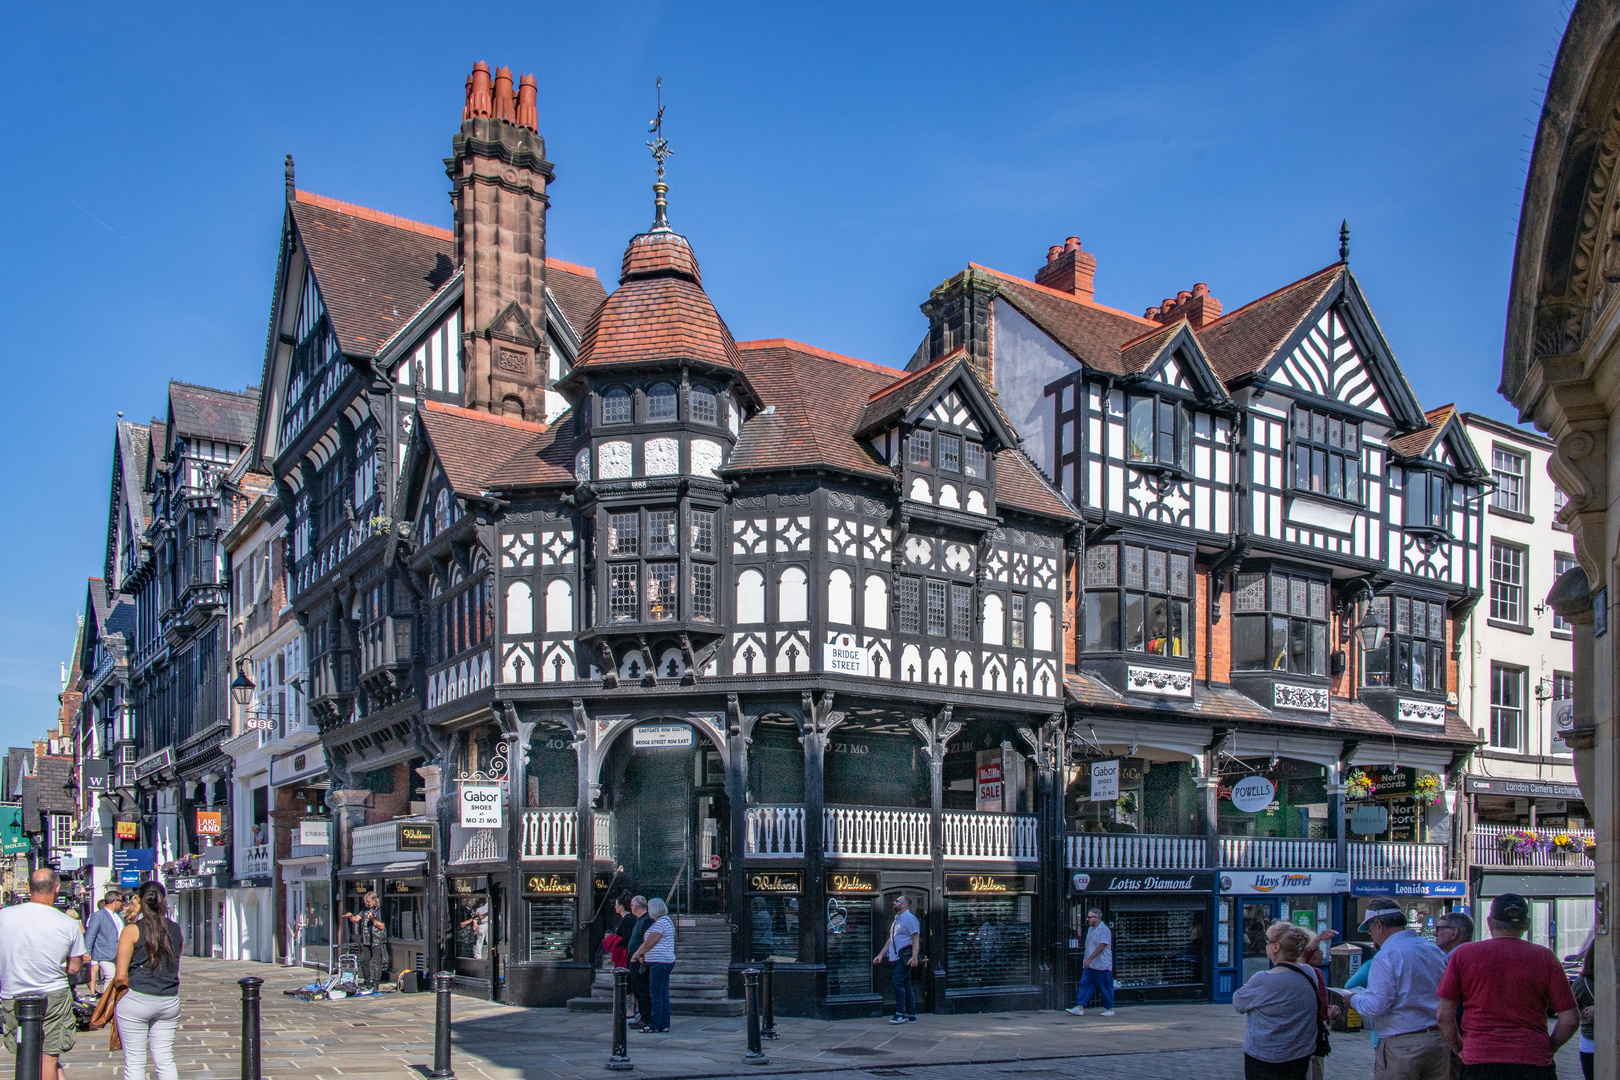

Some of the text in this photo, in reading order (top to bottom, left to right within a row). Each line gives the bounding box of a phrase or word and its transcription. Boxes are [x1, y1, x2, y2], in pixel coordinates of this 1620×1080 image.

[632, 480, 646, 489] 1888
[832, 648, 860, 660] BRIDGE
[832, 660, 860, 670] STREET
[248, 720, 276, 730] TSB
[850, 744, 869, 755] MO
[1093, 766, 1116, 777] Gabor
[89, 777, 103, 786] W
[1382, 773, 1406, 782] North
[981, 785, 999, 799] SALE
[1235, 785, 1270, 798] POWELLS
[1505, 782, 1529, 792] London
[1530, 784, 1553, 793] Camera
[464, 790, 498, 802] Gabor
[403, 830, 431, 839] Waltons
[529, 878, 571, 892] Waltons
[752, 876, 796, 890] Waltons
[834, 875, 872, 890] Waltons
[970, 876, 1006, 891] Waltons
[1108, 875, 1195, 890] Lotus Diamond
[1255, 874, 1311, 888] Hays Travel
[1395, 883, 1430, 894] Leonidas
